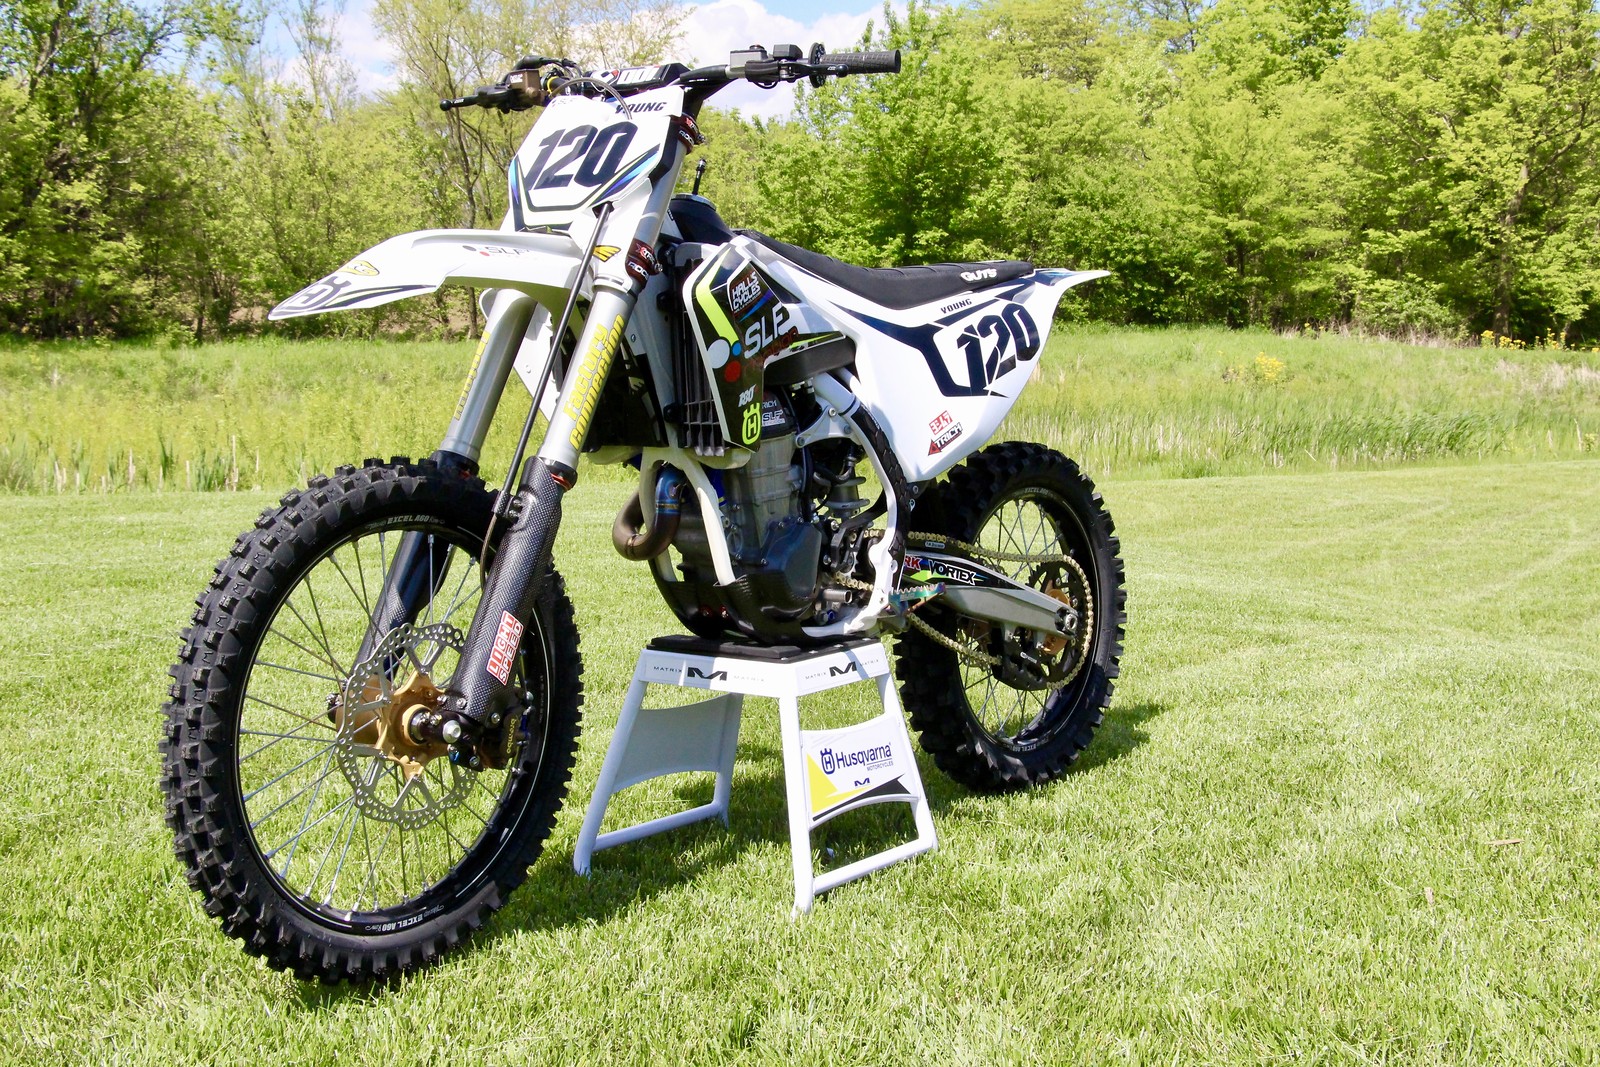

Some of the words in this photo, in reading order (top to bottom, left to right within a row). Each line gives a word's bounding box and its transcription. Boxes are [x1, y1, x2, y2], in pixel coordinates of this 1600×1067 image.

[615, 102, 667, 114] YOUNG
[524, 121, 638, 190] 120
[960, 268, 997, 281] GUTS
[732, 271, 758, 299] HALLS
[733, 281, 761, 310] CYCLES
[940, 299, 972, 314] YOUNG
[957, 303, 1040, 396] 120
[387, 515, 413, 525] EXCEL
[905, 555, 922, 571] RK
[928, 559, 976, 586] VORTEX
[488, 612, 515, 675] LIGHT
[500, 621, 522, 683] SPEED
[835, 744, 892, 769] Husqvarna
[867, 760, 894, 771] MOTORCYCLES
[382, 922, 396, 931] A60
[397, 914, 423, 928] EXCEL
